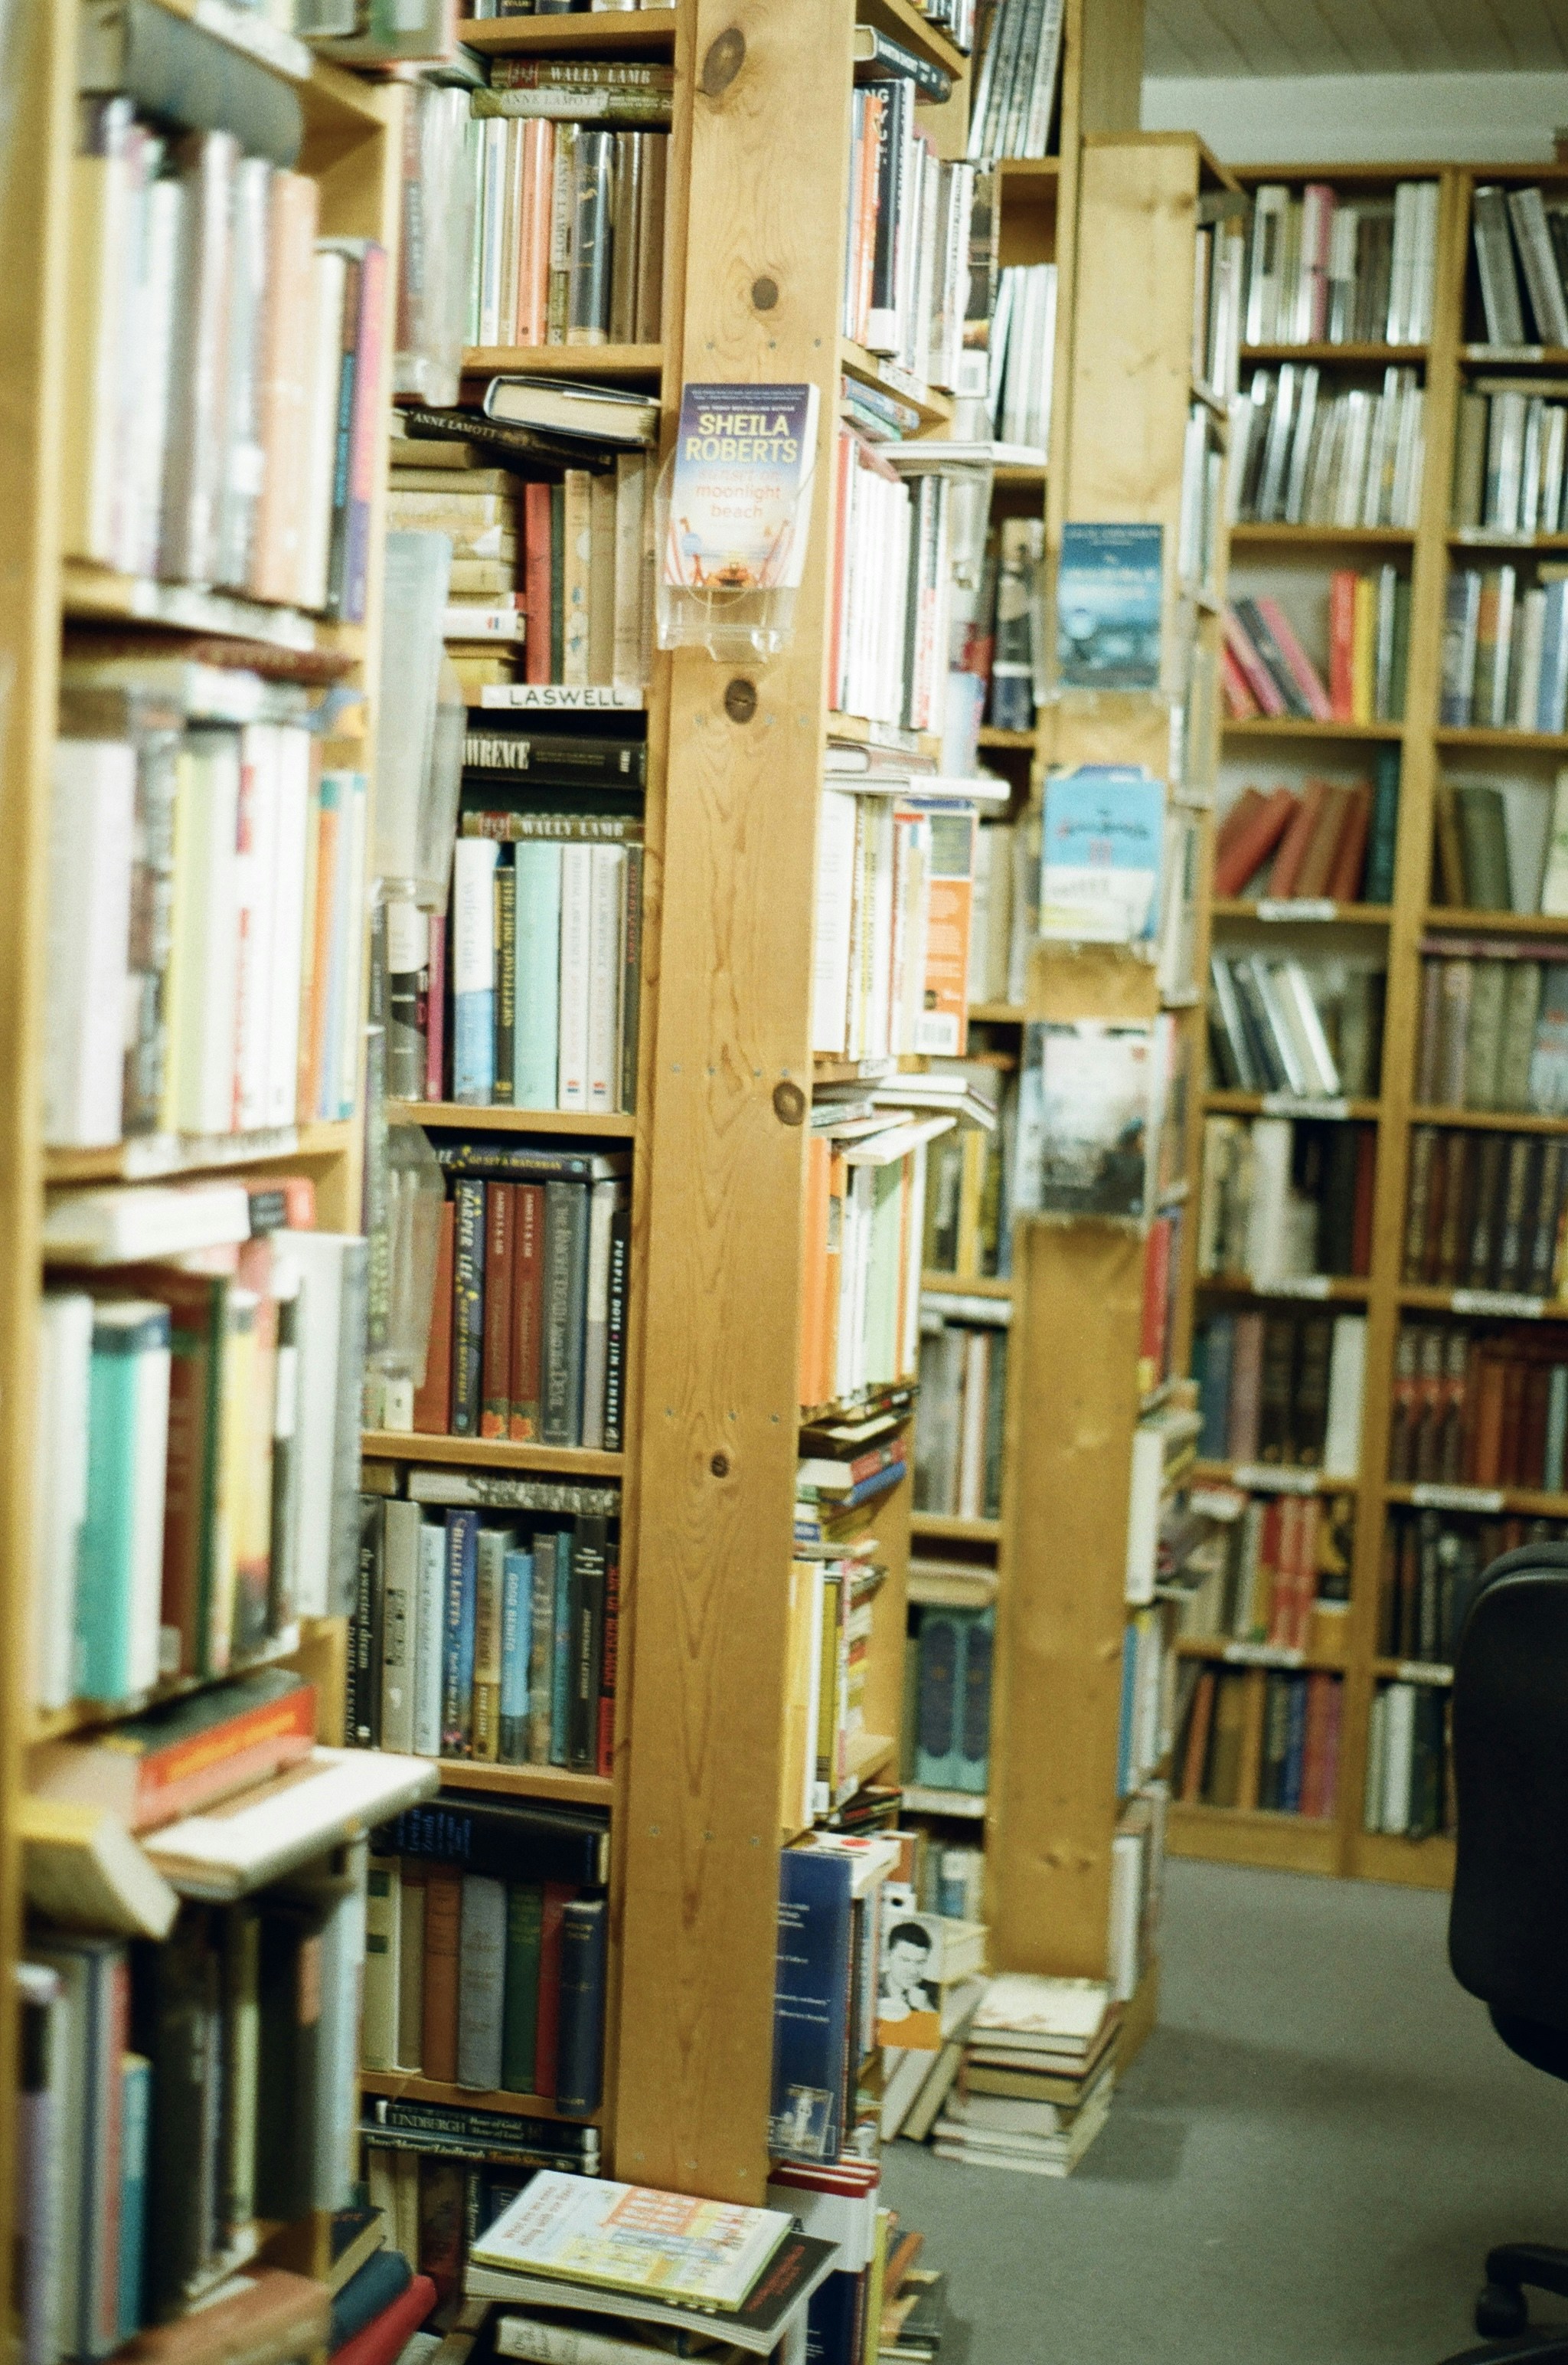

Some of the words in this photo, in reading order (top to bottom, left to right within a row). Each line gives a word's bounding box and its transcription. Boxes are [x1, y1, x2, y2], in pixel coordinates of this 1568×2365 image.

[550, 66, 599, 83] WALLY
[607, 68, 651, 85] LAMB
[414, 412, 446, 430] ANNE
[447, 418, 497, 439] LAMOTT
[698, 414, 790, 437] SHEILA
[685, 436, 798, 463] ROBERTS
[696, 485, 781, 503] moonlight
[710, 504, 763, 518] beach
[509, 689, 626, 707] LASWELL
[461, 738, 531, 770] WRENCE
[459, 1186, 474, 1247] HARPER
[458, 1252, 473, 1281] LEE
[612, 1238, 624, 1292] PURPLE
[611, 1297, 622, 1330] DOTS
[609, 1340, 620, 1365] JIM
[361, 1547, 374, 1568] the
[451, 1526, 464, 1576] BILLIE
[360, 1572, 370, 1624] sweetest
[450, 1579, 463, 1627] LETTS
[507, 1571, 519, 1607] GOOD
[505, 1607, 518, 1652] BENITO
[359, 1627, 374, 1669] dream
[390, 2113, 466, 2134] LINDBERGH
